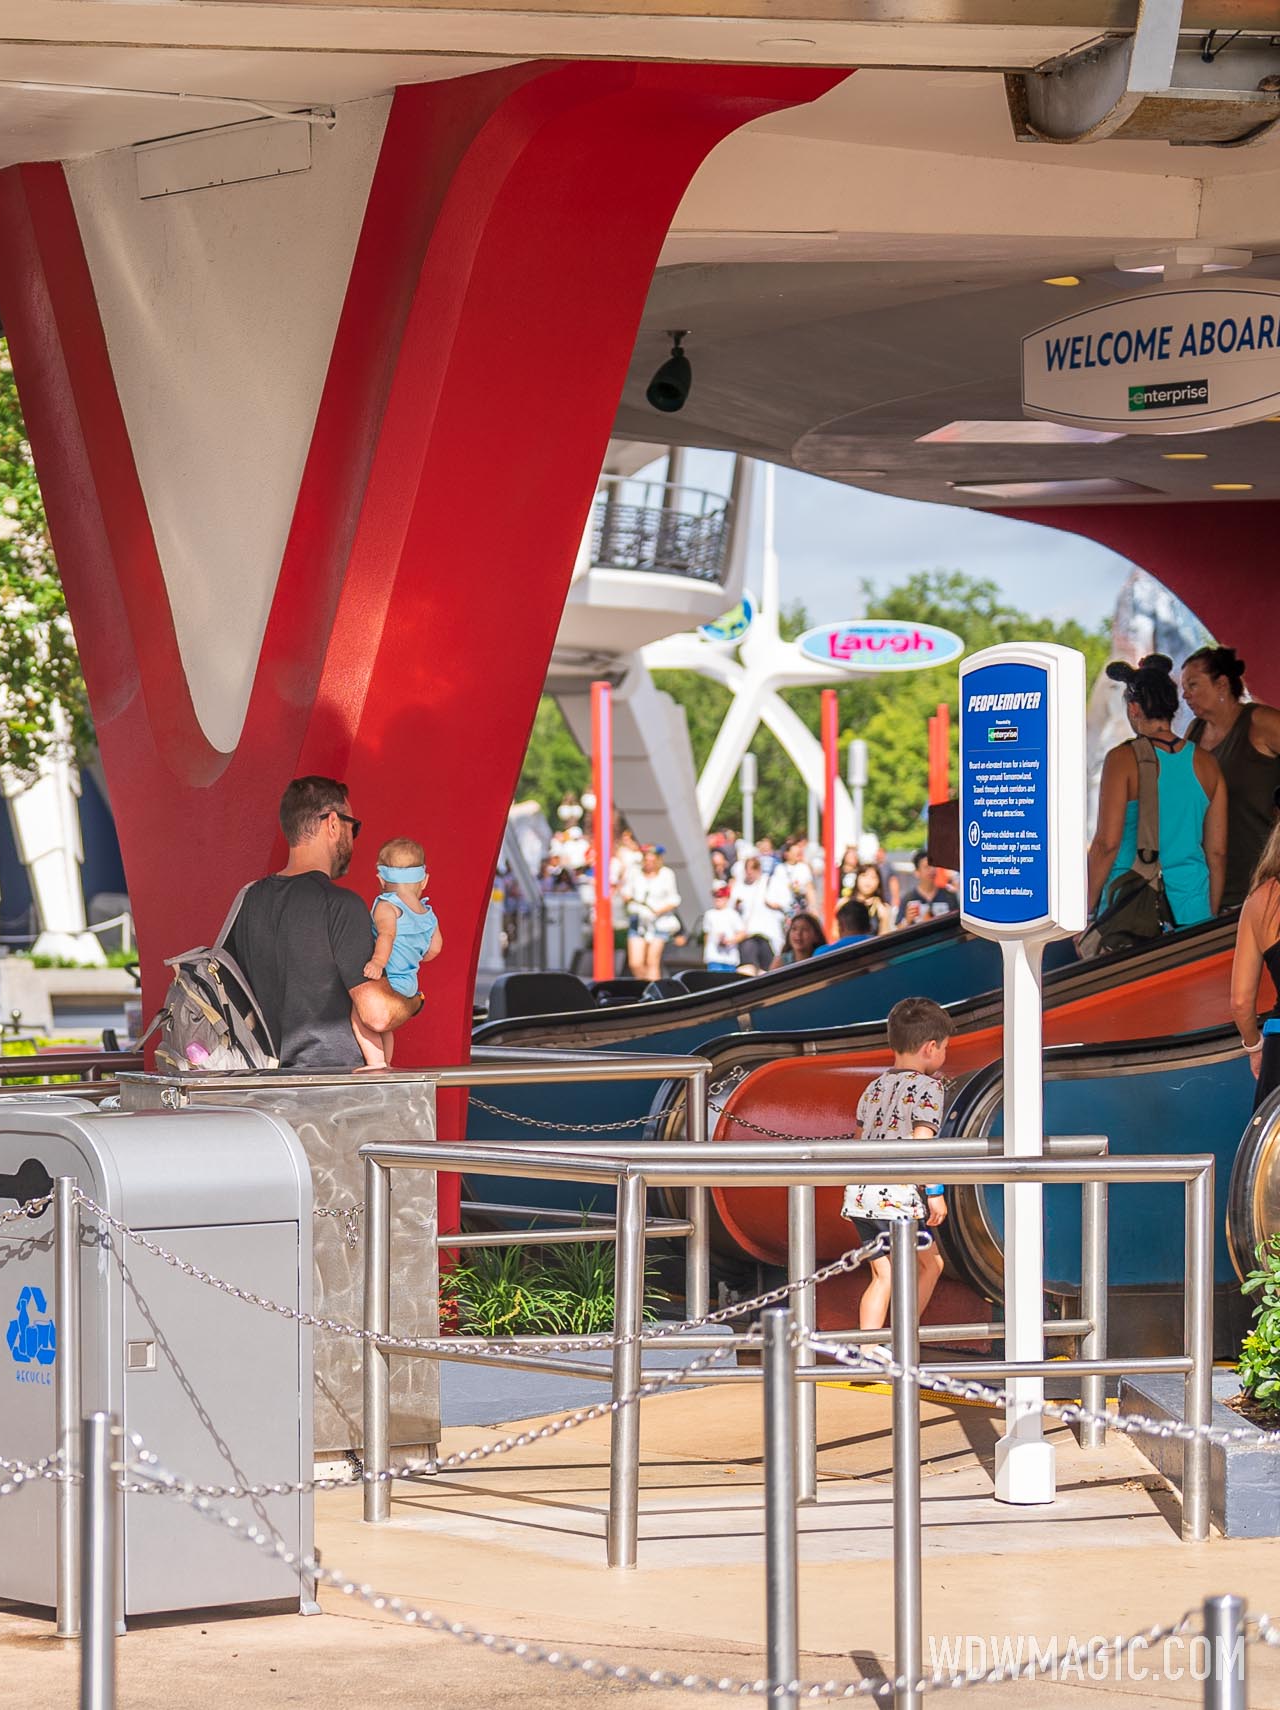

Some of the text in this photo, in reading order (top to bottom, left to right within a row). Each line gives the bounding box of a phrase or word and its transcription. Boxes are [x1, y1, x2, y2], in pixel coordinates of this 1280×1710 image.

[1045, 314, 1280, 372] WELCOME ABOAR
[1132, 384, 1208, 404] enterprise
[828, 630, 934, 660] Laugh
[967, 691, 1041, 713] PEOPLEMOVER
[989, 730, 1018, 740] enterprise
